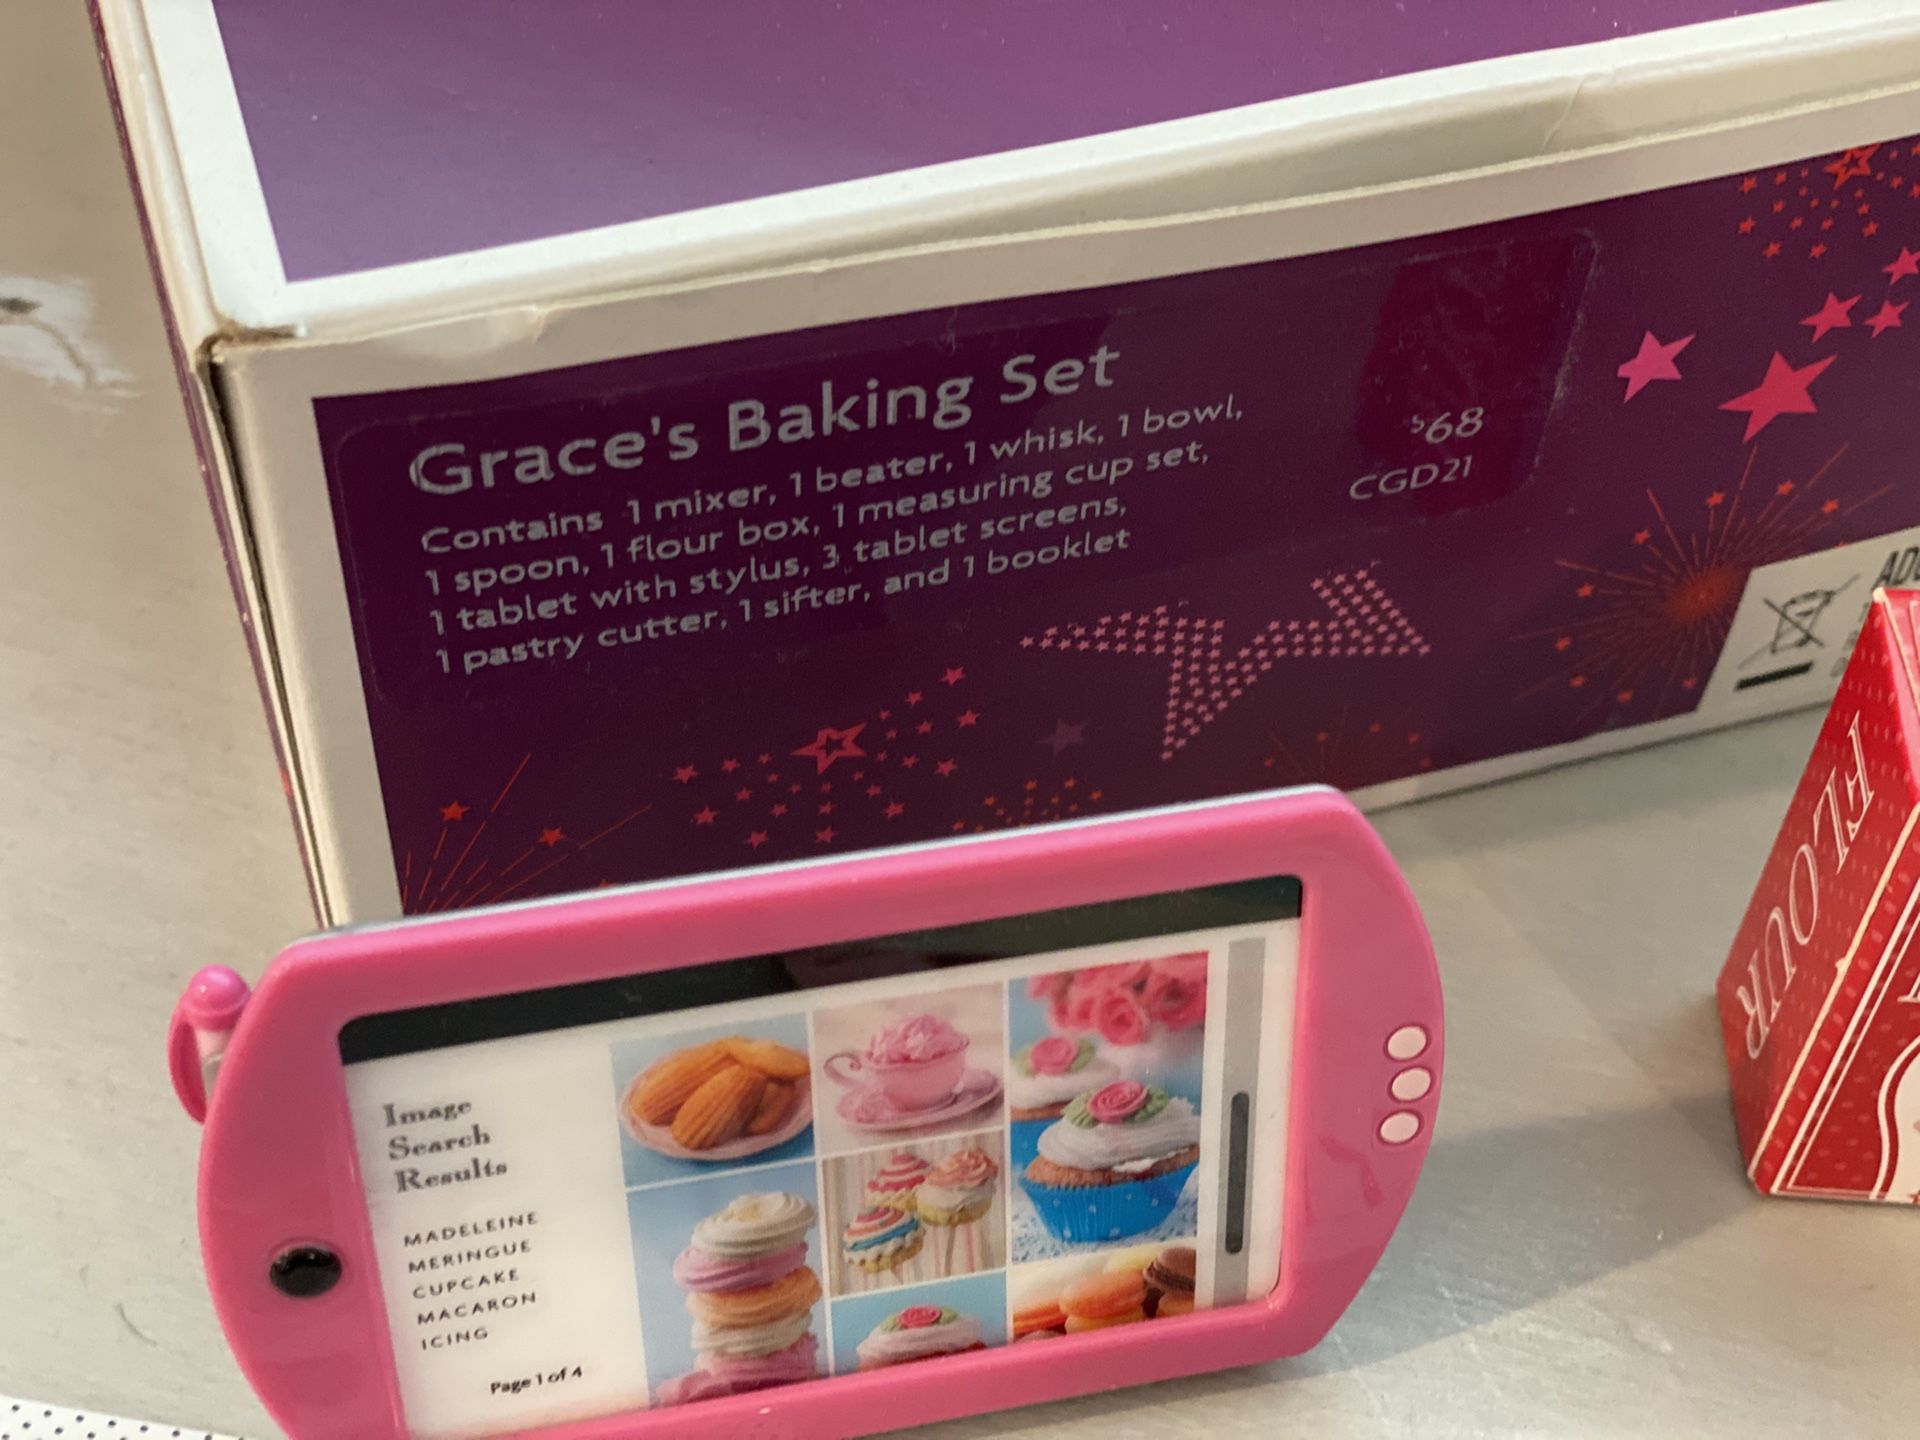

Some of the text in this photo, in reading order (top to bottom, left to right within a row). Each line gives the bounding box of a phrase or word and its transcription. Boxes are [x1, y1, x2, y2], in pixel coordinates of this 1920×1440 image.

[409, 345, 1119, 495] Grace's Baking Set
[421, 394, 1242, 553] Contains 1 mixer, 1 beater, 1 whisk, 1 bowl,
[1349, 455, 1472, 500] CGD21
[425, 441, 1209, 595] 1 spoon, 1 flour box, 1 measuring cup set,
[430, 497, 1126, 635] 1 tablet with stylus, 3 tablet screens,
[436, 528, 1130, 675] 1 pastry cutter, 1 sifter, and 1 booklet
[1736, 710, 1875, 1060] FLOUR
[383, 1102, 471, 1126] Image
[388, 1124, 490, 1160] Search
[397, 1158, 507, 1193] Results
[404, 1212, 537, 1247] MADELEINE
[409, 1240, 531, 1273] MERINGUE
[413, 1269, 519, 1299] CUPCAKE
[417, 1292, 536, 1325] MACARON
[422, 1327, 488, 1350] ICING
[491, 1366, 582, 1394] Page 1 of 4
